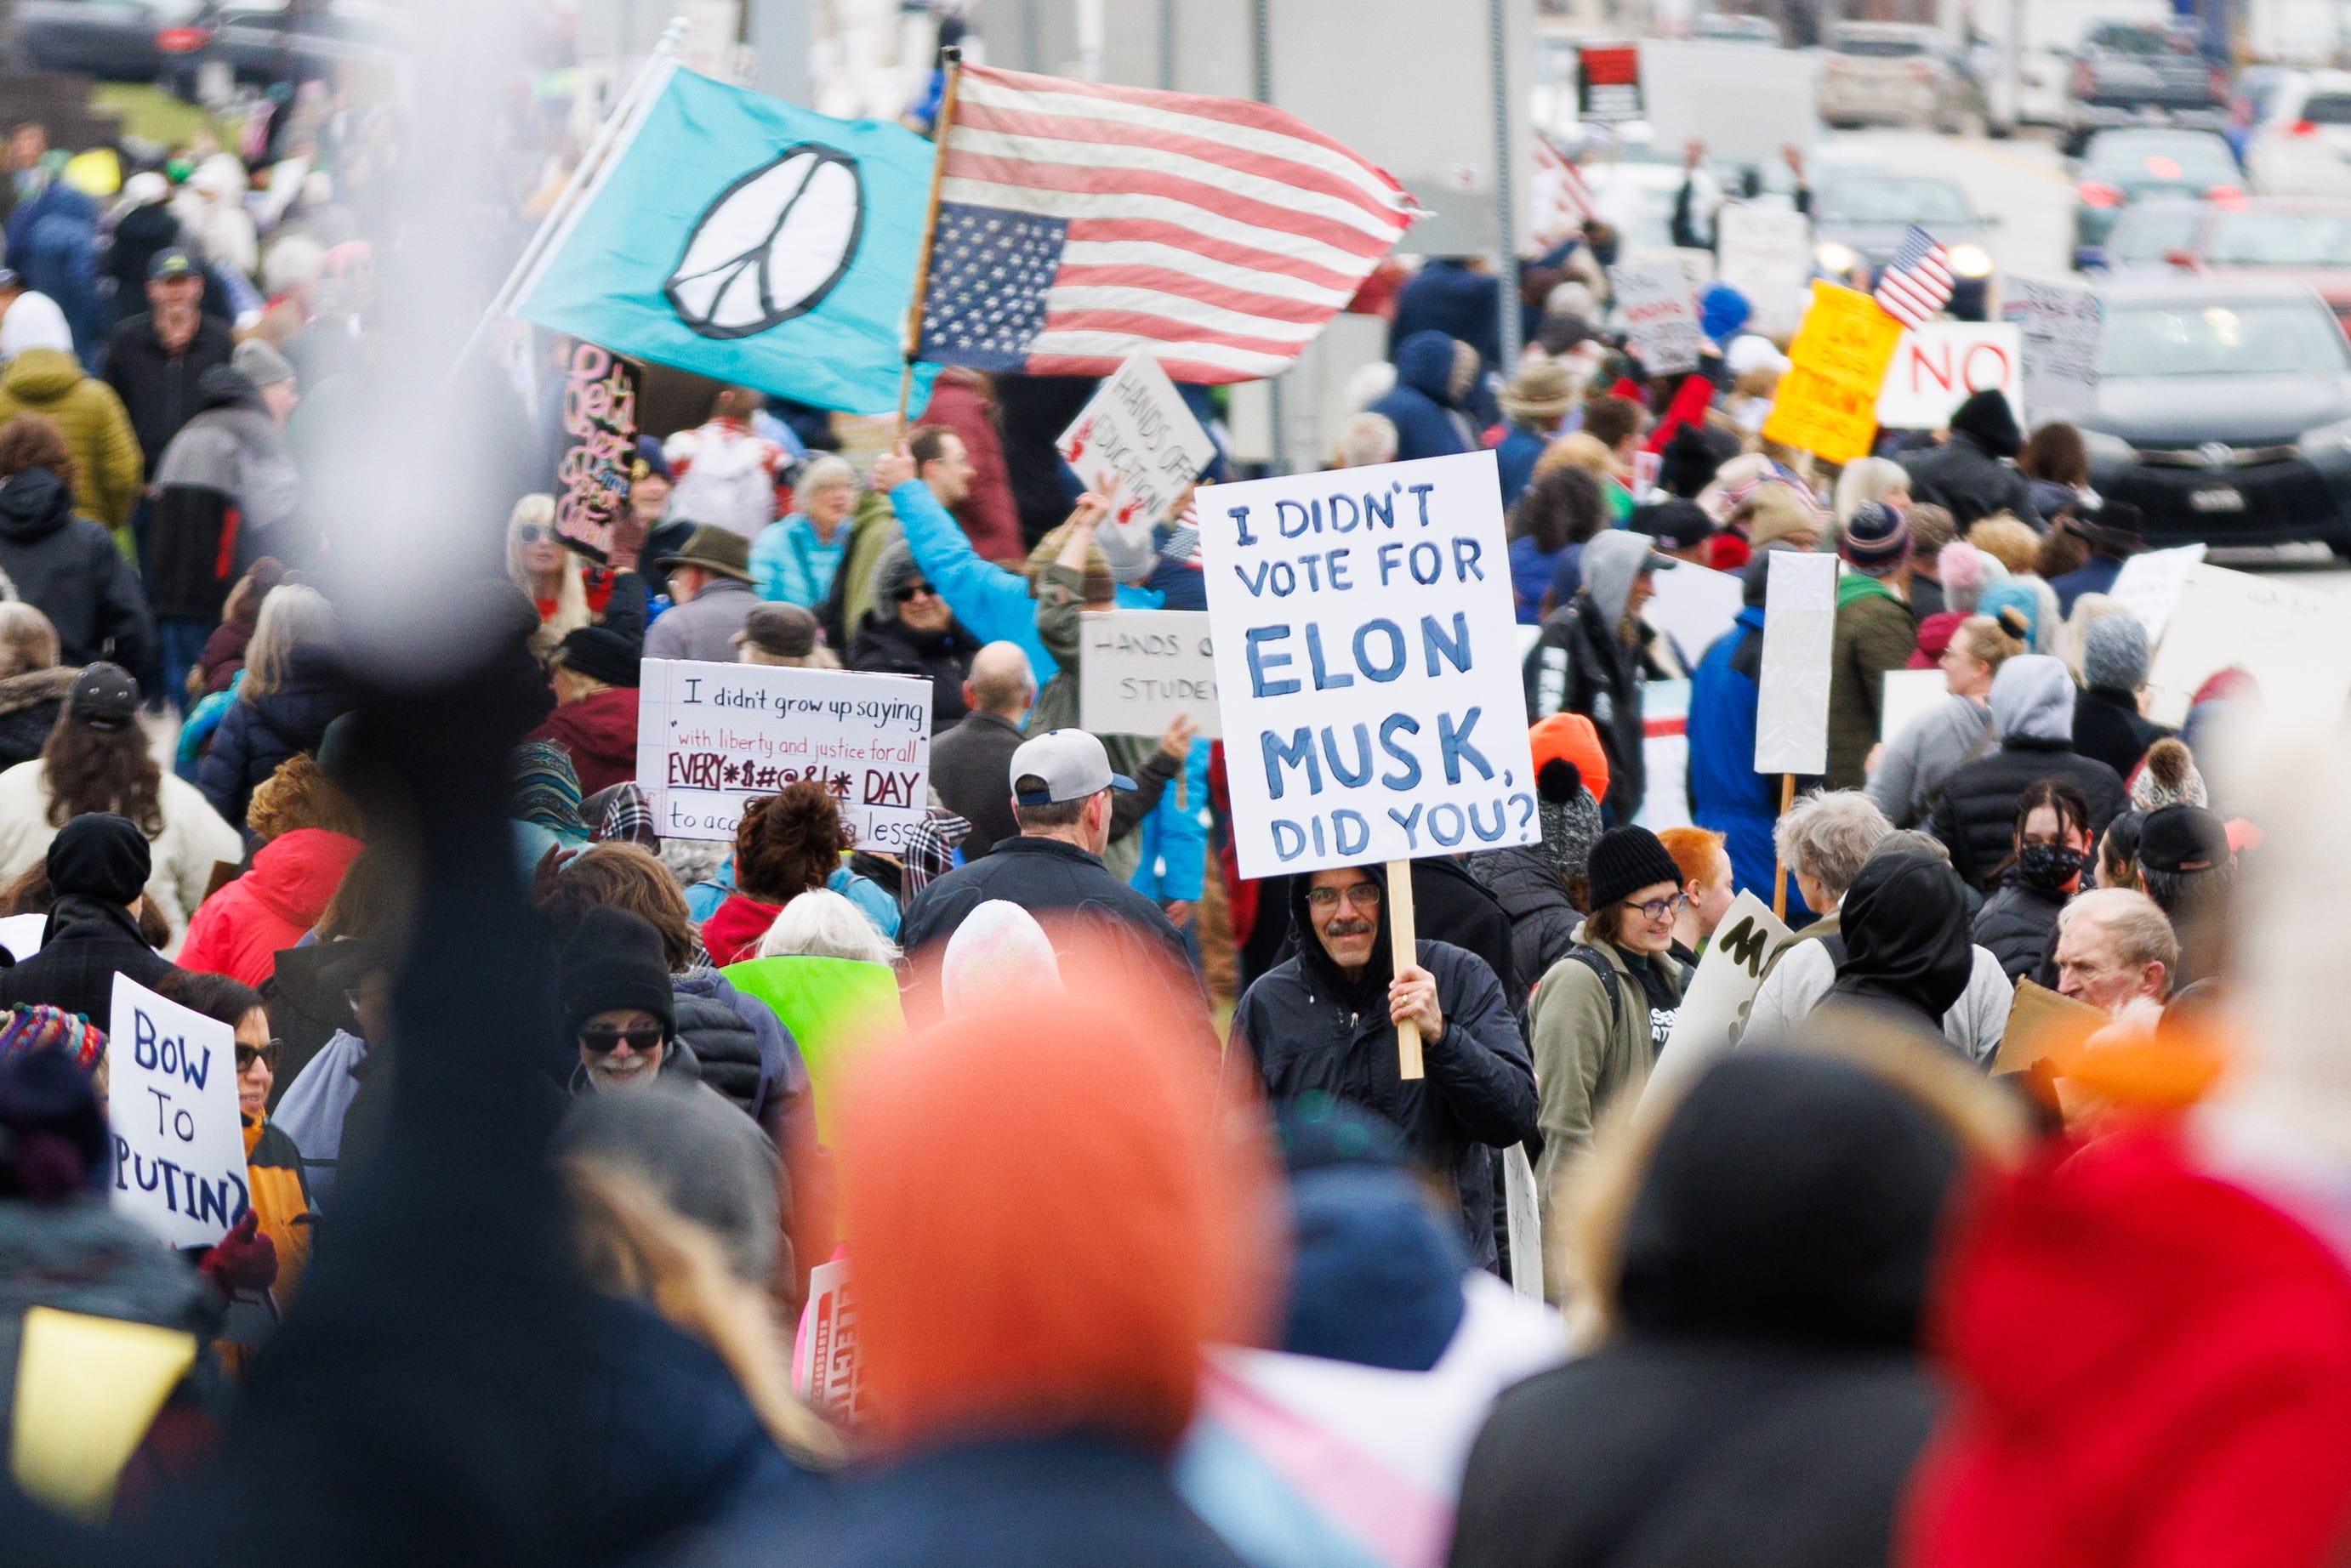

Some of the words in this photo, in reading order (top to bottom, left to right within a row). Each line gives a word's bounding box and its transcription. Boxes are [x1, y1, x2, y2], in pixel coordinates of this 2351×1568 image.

[1911, 341, 2011, 395] NO
[1113, 368, 1172, 451] HANDS
[1158, 444, 1201, 486] OFF
[1227, 506, 1258, 547] I
[1275, 480, 1435, 539] DIDN'T
[1234, 548, 1354, 598] VOTE
[1377, 536, 1485, 587] FOR
[1094, 633, 1180, 656] HANDS
[1245, 611, 1473, 699] ELON
[683, 679, 703, 703] I
[714, 687, 767, 710] didn't
[775, 696, 823, 719] grow
[828, 699, 852, 723] up
[857, 697, 924, 733] saying
[720, 728, 773, 758] liberty
[779, 736, 807, 753] and
[812, 736, 865, 764] justice
[870, 738, 896, 762] for
[1260, 706, 1514, 800] MUSK,
[669, 801, 697, 828] to
[863, 769, 920, 808] DAY
[1271, 808, 1370, 863] DID
[1387, 793, 1534, 850] YOU?
